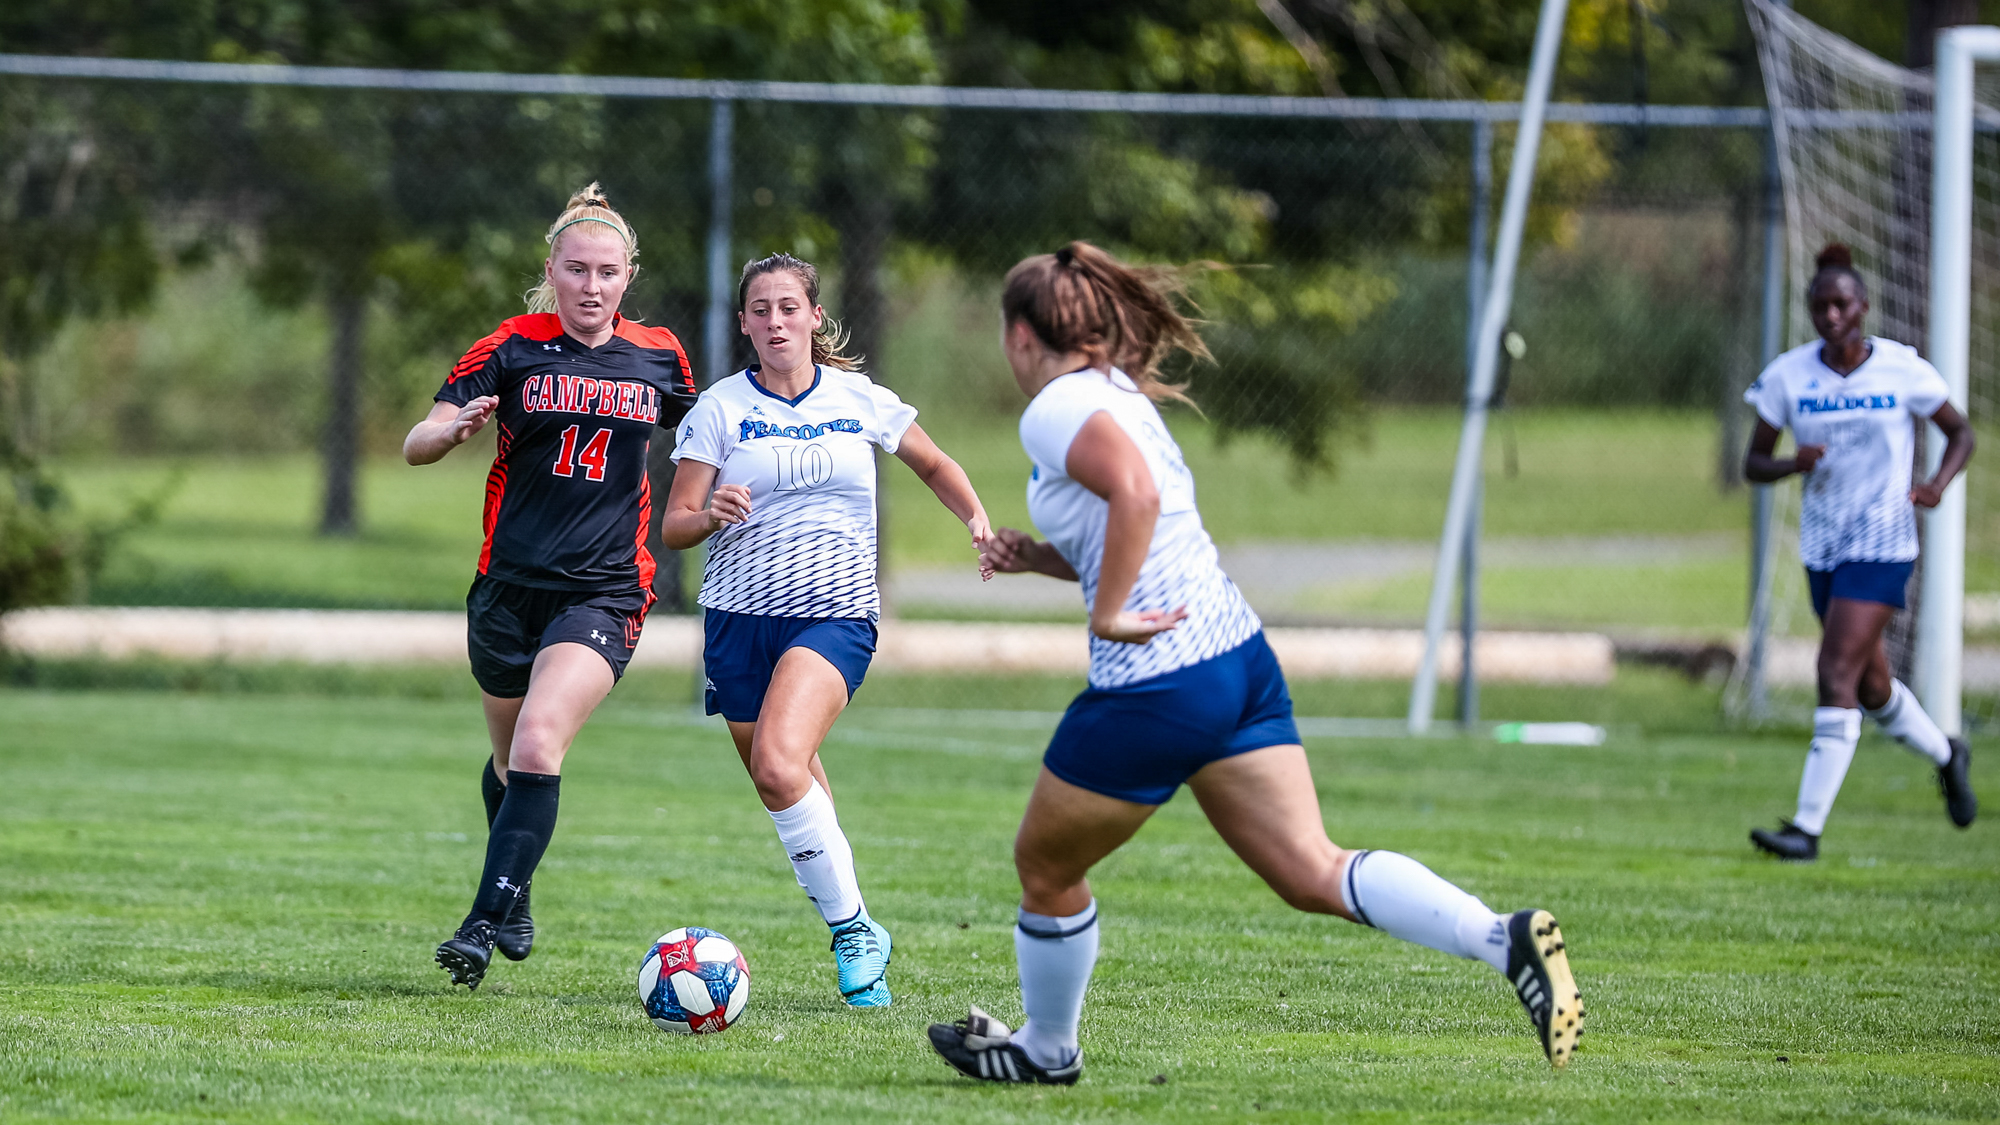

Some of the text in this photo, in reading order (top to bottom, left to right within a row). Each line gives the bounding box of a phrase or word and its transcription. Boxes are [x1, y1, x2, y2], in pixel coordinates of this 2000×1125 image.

[522, 374, 659, 425] CAMPBELL
[552, 424, 613, 482] 14
[739, 418, 864, 442] PEACOCKS
[772, 443, 833, 492] 10
